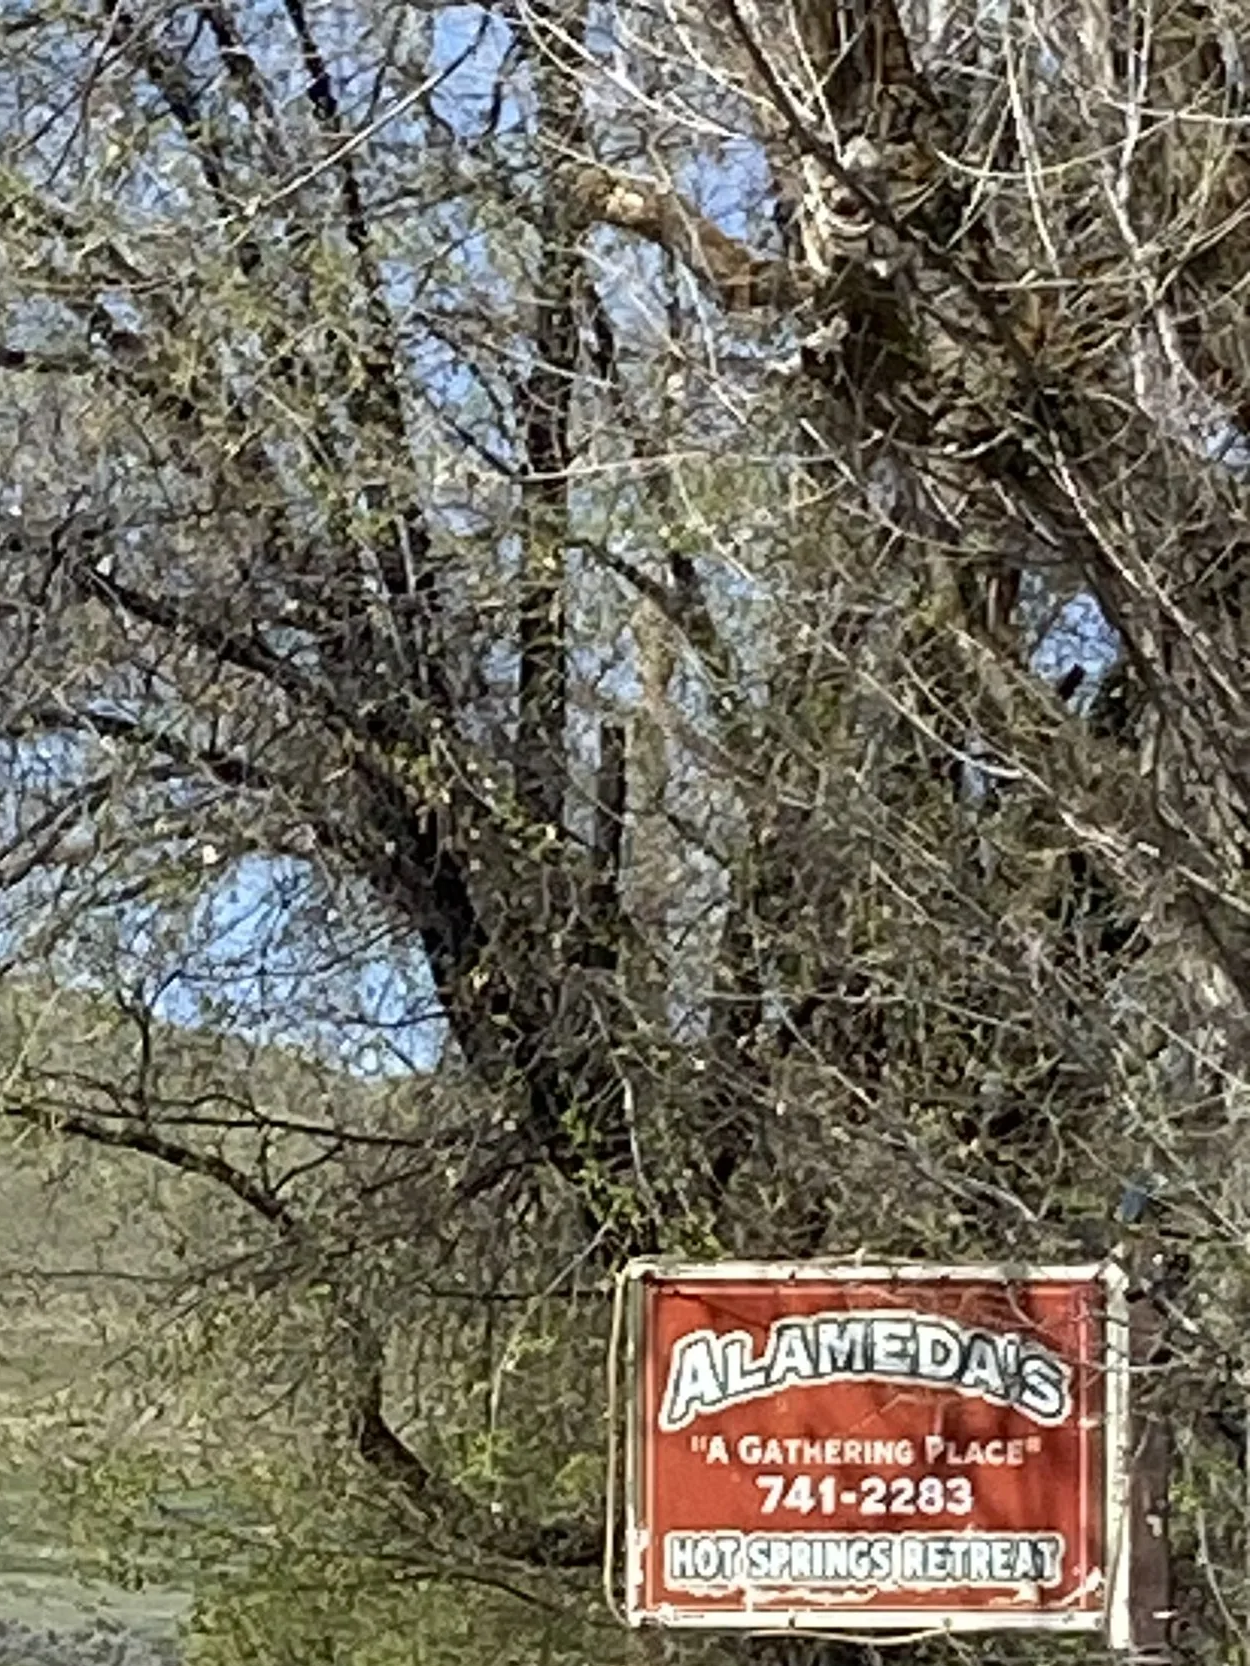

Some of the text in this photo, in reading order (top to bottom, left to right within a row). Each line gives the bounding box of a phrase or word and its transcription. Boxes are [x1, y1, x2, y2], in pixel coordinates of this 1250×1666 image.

[662, 1311, 1069, 1429] ALAMEDA'S
[738, 1435, 914, 1466] GATHERING
[755, 1475, 974, 1516] 741-2283
[670, 1536, 1059, 1582] HOT SPRINGS RETREAT
